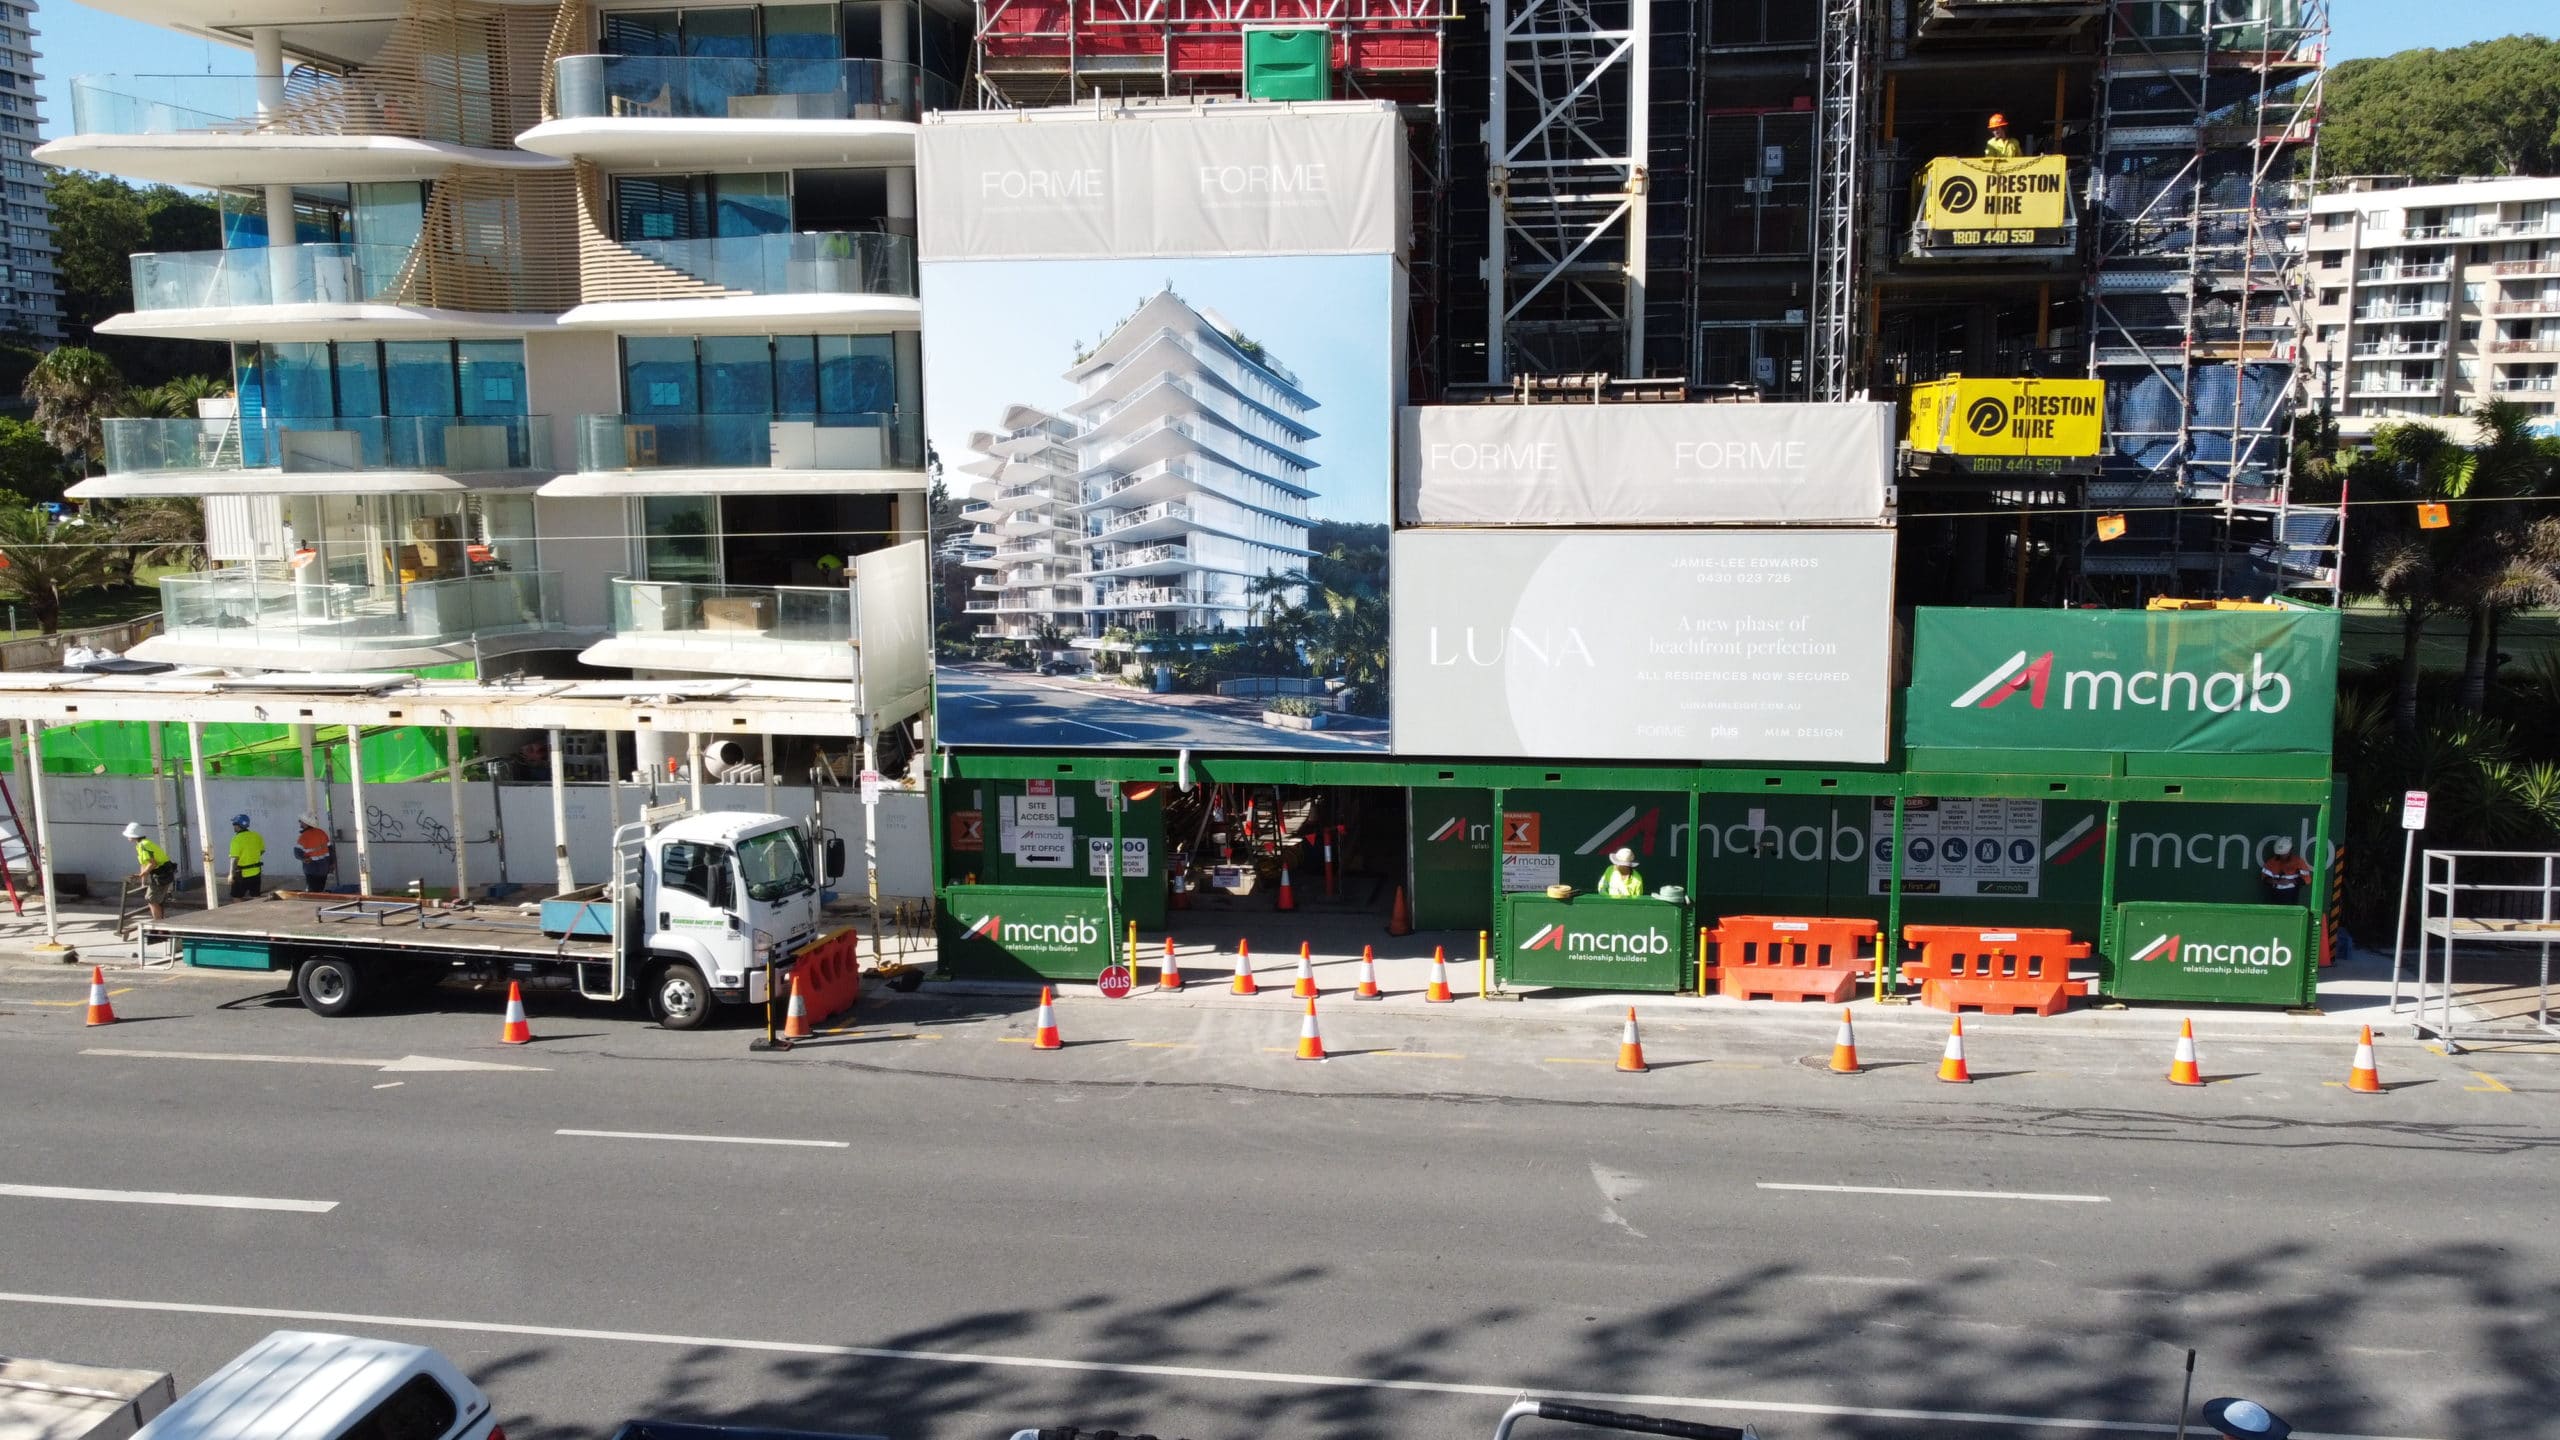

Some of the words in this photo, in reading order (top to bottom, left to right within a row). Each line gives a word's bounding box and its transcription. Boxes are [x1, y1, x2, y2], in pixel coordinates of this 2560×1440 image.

[982, 169, 1104, 198] FORME
[1201, 164, 1327, 194] FORME
[1986, 174, 2060, 194] PRESTON
[1984, 196, 2022, 215] HIRE
[1953, 231, 1980, 244] 1800
[1984, 231, 2008, 244] 440
[2010, 230, 2034, 244] 550
[2013, 396, 2096, 417] PRESTON
[2011, 418, 2054, 439] HIRE
[1430, 442, 1558, 471] FORME
[1675, 440, 1806, 471] FORME
[1973, 457, 2001, 472] 1800
[2006, 458, 2032, 472] 440
[2036, 457, 2062, 472] 550
[1671, 558, 1745, 568] JAMIE-LEE
[1750, 558, 1819, 568] EDWARDS
[1697, 573, 1732, 584] 0430
[1678, 615, 1690, 632] A
[1696, 619, 1728, 632] new
[1735, 614, 1785, 637] phase
[1789, 615, 1811, 632] of
[1430, 626, 1596, 667] LUNA
[1648, 636, 1741, 655] beachfront
[1747, 636, 1837, 659] perfection
[1637, 672, 1660, 681] ALL
[1665, 672, 1748, 681] RESIDENCES
[1752, 672, 1783, 681] NOW
[1786, 672, 1850, 681] SECURED
[2063, 652, 2292, 714] mcnab
[1711, 724, 1739, 738] plus
[1797, 727, 1844, 737] DESIGN
[1028, 802, 1047, 810] SITE
[1020, 813, 1055, 821] ACCESS
[1034, 831, 1064, 840] mcnab
[1670, 808, 1865, 863] mcnab
[1518, 855, 1556, 866] mcnab
[1996, 884, 2024, 892] mcnab
[1004, 917, 1098, 945] mcnab
[1005, 943, 1047, 953] relationship
[1049, 944, 1079, 953] builders
[1568, 926, 1669, 954] mcnab
[1569, 953, 1614, 963] relationship
[1616, 954, 1648, 963] builders
[2183, 937, 2292, 967] mcnab
[2183, 965, 2232, 975] relationship
[2235, 966, 2269, 976] builders
[1101, 975, 1130, 990] STOP
